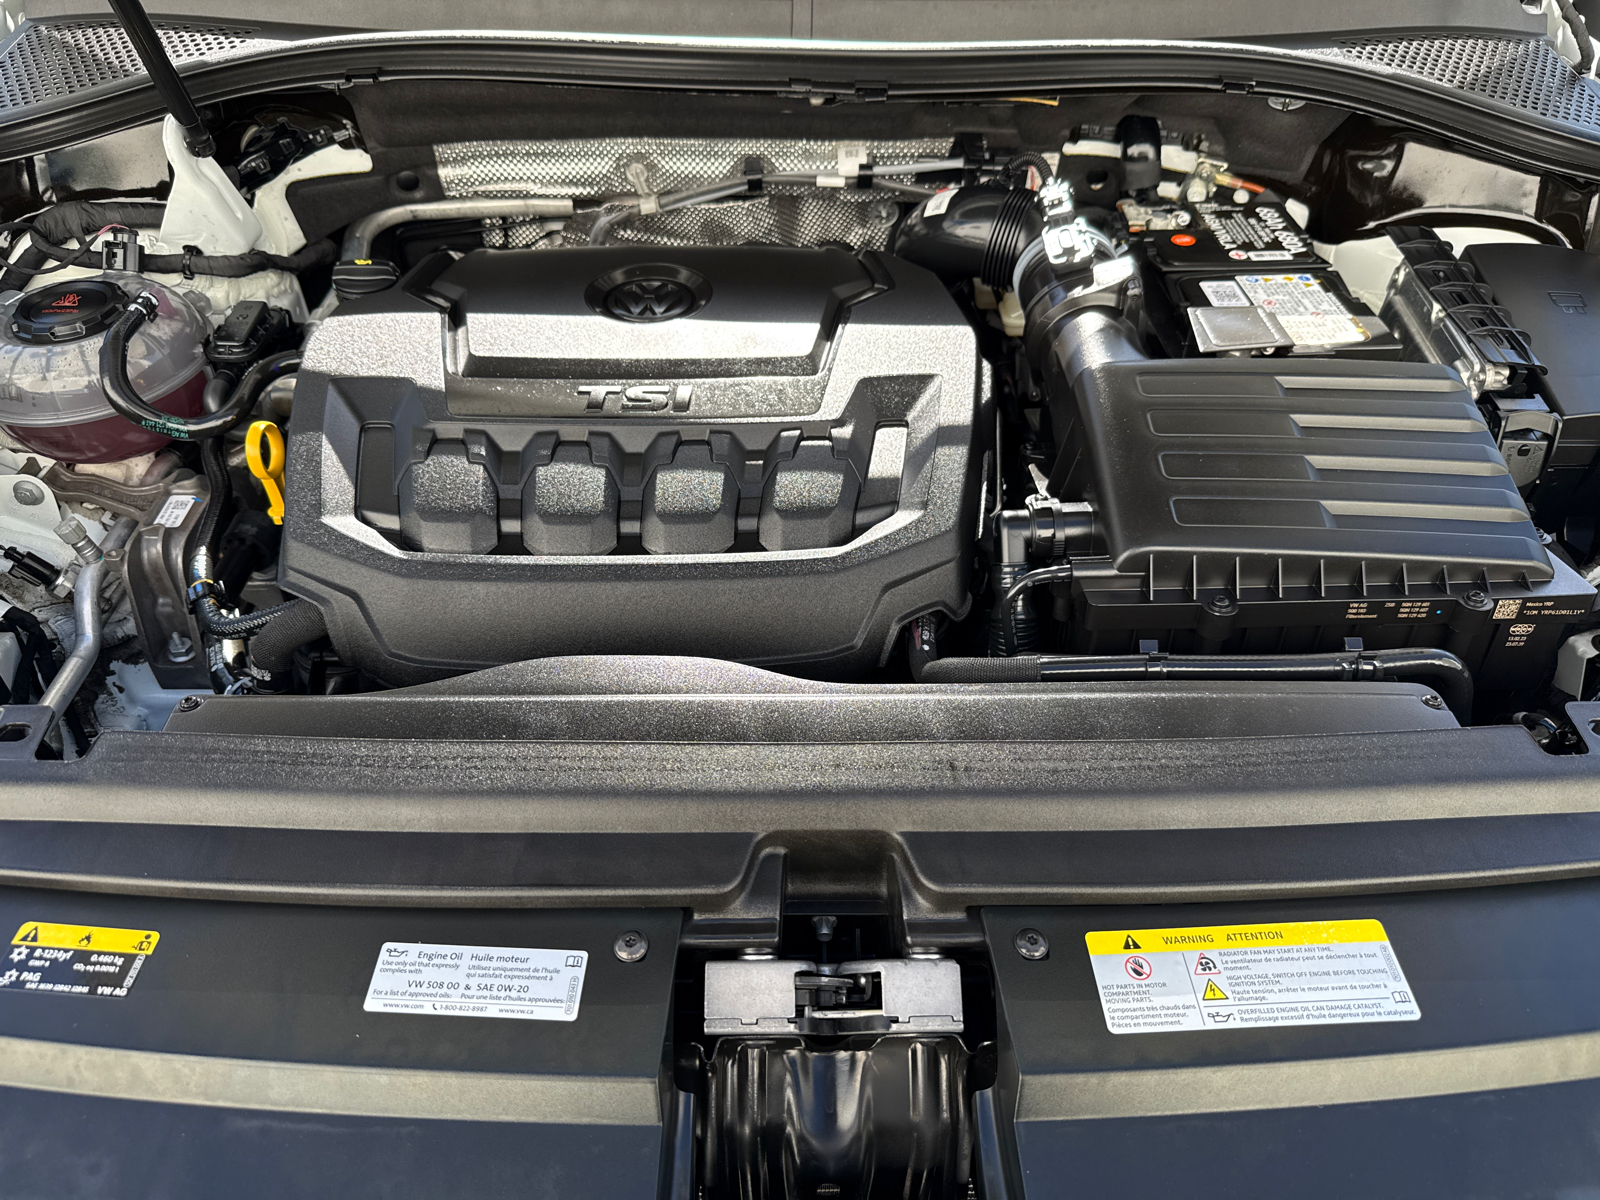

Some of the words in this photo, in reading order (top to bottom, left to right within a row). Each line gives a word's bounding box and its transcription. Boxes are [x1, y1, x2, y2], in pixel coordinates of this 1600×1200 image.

[1255, 207, 1287, 230] 68Ah
[1274, 230, 1307, 253] 680A
[578, 384, 692, 413] TSI
[1162, 934, 1214, 944] WARNING
[1226, 931, 1284, 942] ATTENTION
[90, 954, 114, 964] 0.460
[113, 955, 124, 966] kg
[417, 951, 448, 961] Engine
[450, 952, 463, 960] Oil
[470, 953, 494, 962] Huile
[496, 955, 530, 963] moteur
[19, 971, 42, 982] PAG
[97, 986, 114, 995] VW
[112, 987, 128, 996] AG
[407, 980, 425, 988] VW
[426, 981, 445, 989] 508
[446, 982, 460, 990] 00
[476, 983, 495, 992] SAE
[497, 984, 530, 993] 0W-20
[440, 1004, 488, 1012] 1-800-822-8987
[1108, 1006, 1145, 1014] Composants
